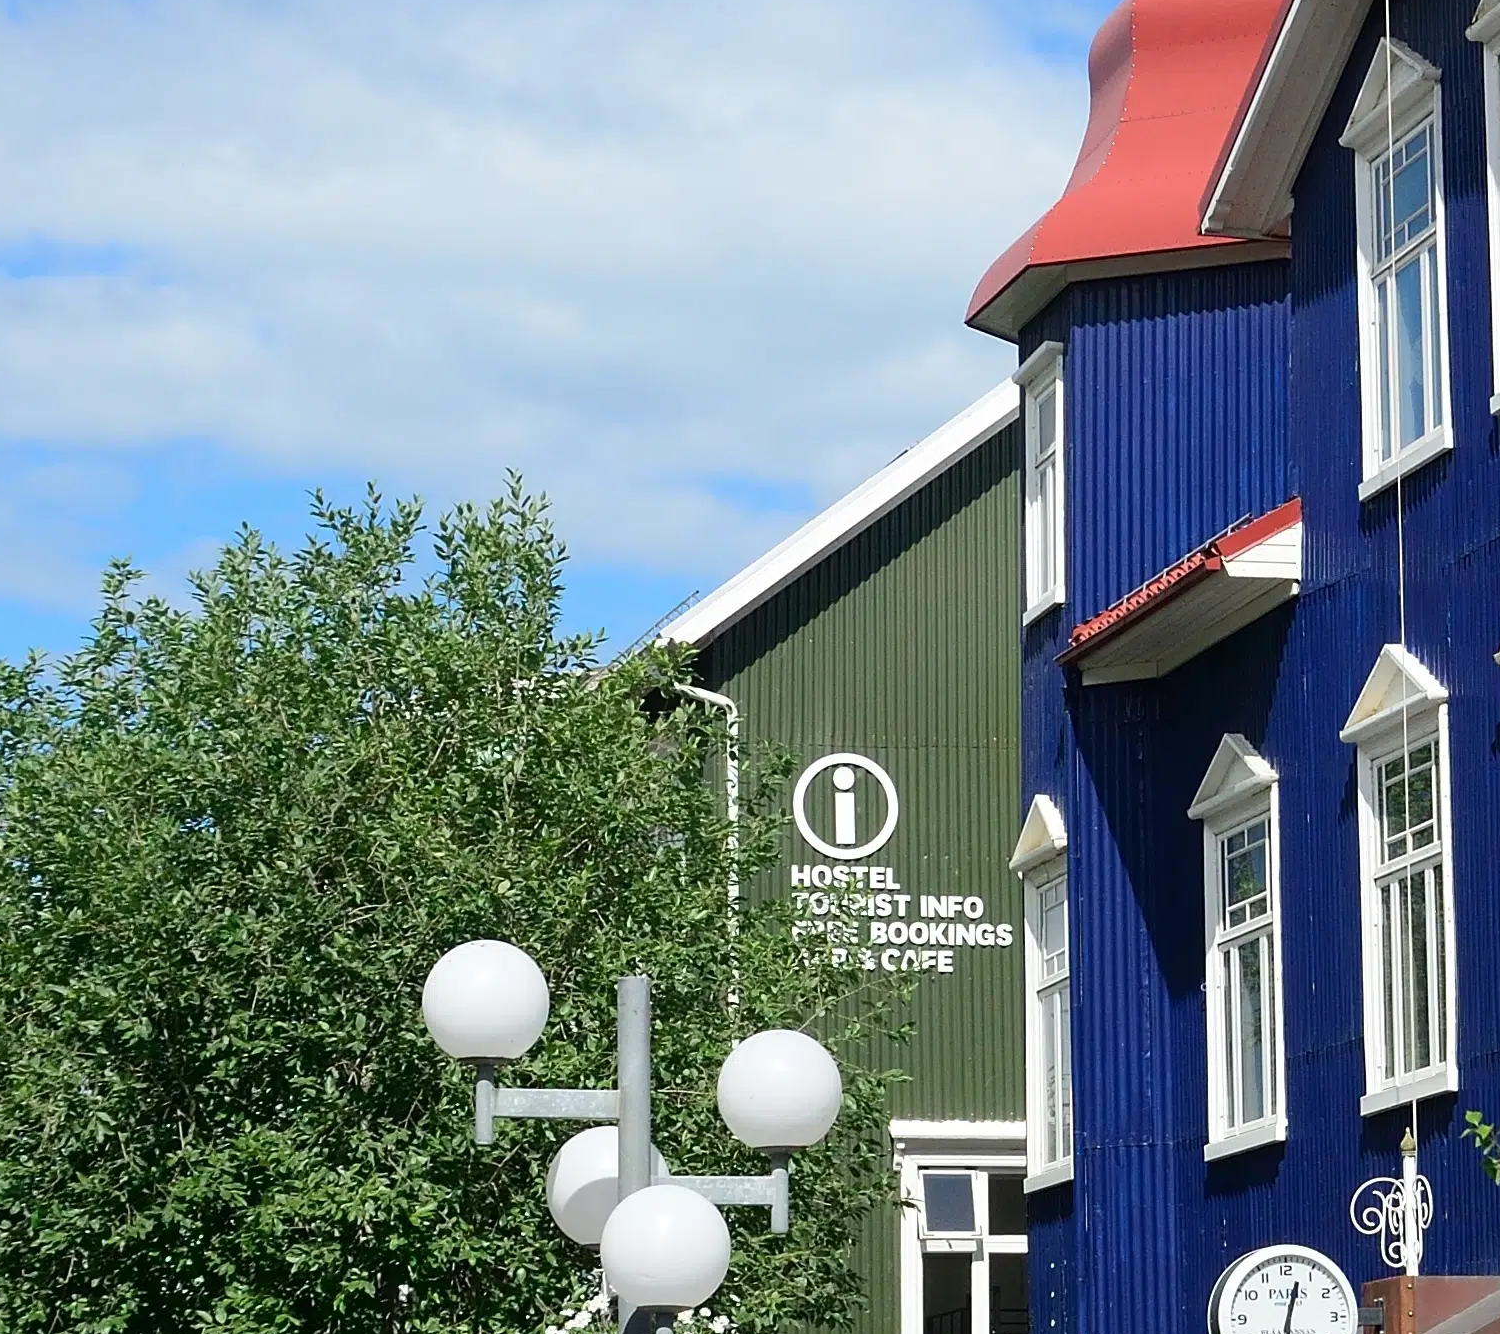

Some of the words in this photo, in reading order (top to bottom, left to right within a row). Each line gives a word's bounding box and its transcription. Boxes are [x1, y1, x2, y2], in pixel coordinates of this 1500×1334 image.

[791, 864, 901, 890] HOSTEL
[920, 895, 985, 920] INFO
[870, 921, 1014, 947] BOOKINGS
[1279, 1265, 1293, 1276] 12
[1261, 1273, 1269, 1284] 11
[1244, 1290, 1258, 1301] 10
[1268, 1288, 1308, 1300] PARS
[1321, 1288, 1331, 1299] 2
[1237, 1314, 1247, 1325] 9
[1329, 1311, 1339, 1322] 3
